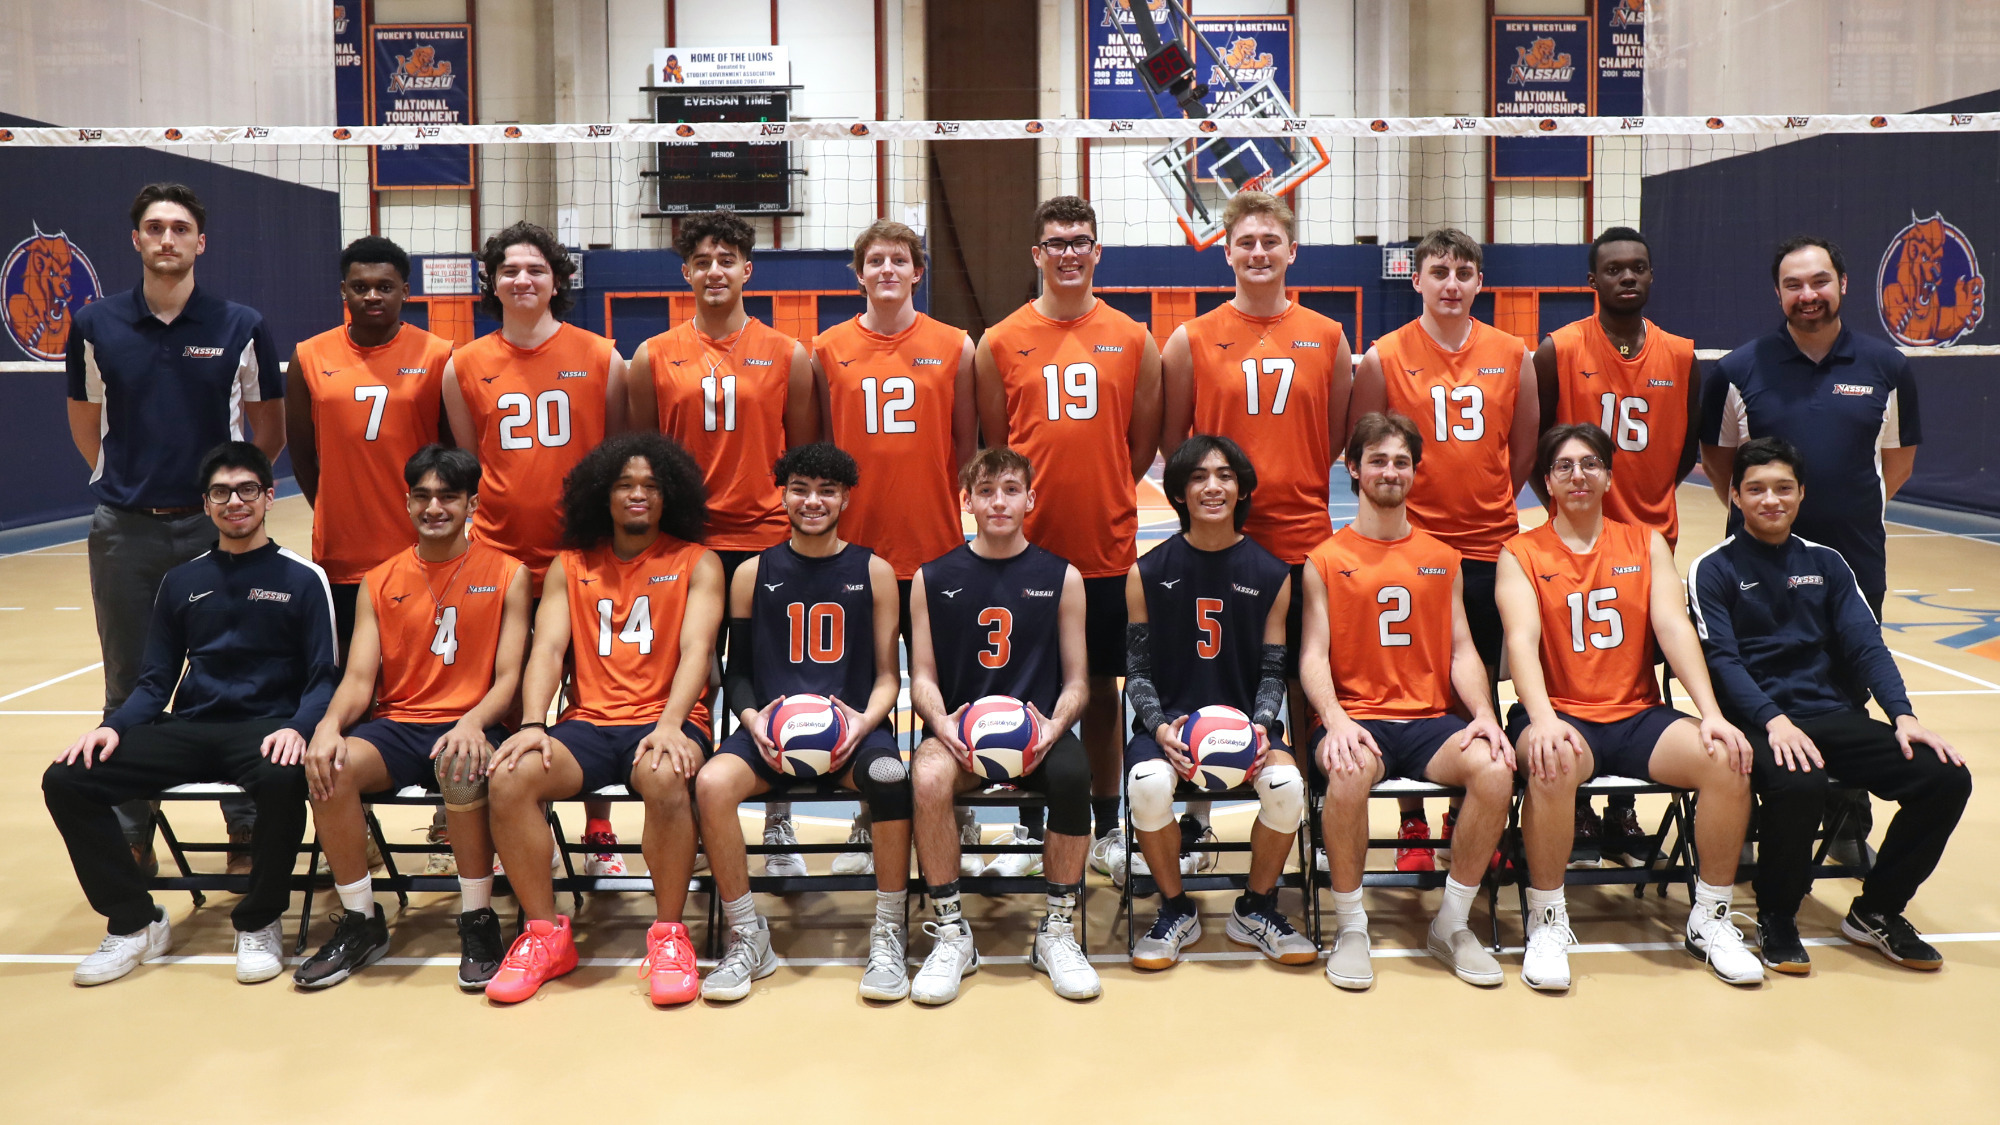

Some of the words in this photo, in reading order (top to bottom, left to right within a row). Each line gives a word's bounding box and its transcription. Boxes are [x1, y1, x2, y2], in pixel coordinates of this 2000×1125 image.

[1236, 23, 1287, 32] BASKETBALL
[1506, 23, 1530, 31] MEN'S
[1532, 23, 1577, 32] WRESTLING
[377, 31, 412, 40] WOMEN'S
[415, 31, 464, 39] VOLLEYBALL
[1612, 33, 1640, 45] DUAL
[690, 53, 716, 63] HOME
[717, 53, 728, 62] OF
[730, 52, 746, 62] THE
[747, 52, 773, 62] LIONS
[1507, 66, 1575, 87] NASSAU
[1602, 70, 1618, 78] 2001
[1622, 70, 1640, 78] 2002
[387, 73, 455, 95] NASSAU
[684, 95, 739, 107] EVERSAN
[745, 94, 772, 106] TIME
[1515, 91, 1568, 102] NATIONAL
[395, 99, 449, 110] NATIONAL
[1497, 102, 1586, 114] CHAMPIONSHIPS
[385, 111, 459, 123] TOURNAMENT
[1784, 116, 1809, 129] NCC
[1950, 114, 1973, 126] NCC
[760, 124, 785, 136] NCC
[935, 122, 959, 134] NCC
[1109, 121, 1133, 132] NCC
[1282, 120, 1307, 131] NCC
[1453, 118, 1476, 130] NCC
[1620, 118, 1644, 130] NCC
[79, 129, 102, 142] NCC
[244, 127, 268, 138] NCC
[415, 127, 440, 139] NCC
[587, 125, 612, 137] NCC
[1093, 344, 1123, 353] NASSAU
[1290, 340, 1320, 349] NASSAU
[183, 346, 225, 358] NASSAU
[742, 358, 773, 367] NASSAU
[912, 358, 943, 367] NASSAU
[396, 367, 427, 376] NASSAU
[557, 370, 588, 380] NASSAU
[1477, 367, 1505, 376] NASSAU
[1241, 357, 1296, 415] 17
[1646, 379, 1674, 388] NASSAU
[1042, 362, 1098, 421] 19
[1832, 384, 1874, 396] NASSAU
[701, 375, 737, 432] 11
[861, 376, 916, 434] 12
[354, 385, 389, 441] 7
[1430, 384, 1485, 442] 13
[497, 389, 571, 450] 20
[1600, 392, 1649, 452] 16
[1416, 566, 1447, 576] NASSAU
[648, 574, 679, 586] NASSAU
[1787, 574, 1824, 589] NASSAU
[248, 588, 292, 603] NASSAU
[466, 585, 497, 595] NASSAU
[1022, 588, 1054, 598] NASSAU
[1231, 583, 1260, 597] NASSAU
[1377, 585, 1411, 647] 2
[1566, 586, 1624, 652] 15
[597, 595, 654, 657] 14
[1196, 597, 1223, 659] 5
[430, 606, 458, 666] 4
[787, 602, 845, 664] 10
[977, 606, 1013, 669] 3
